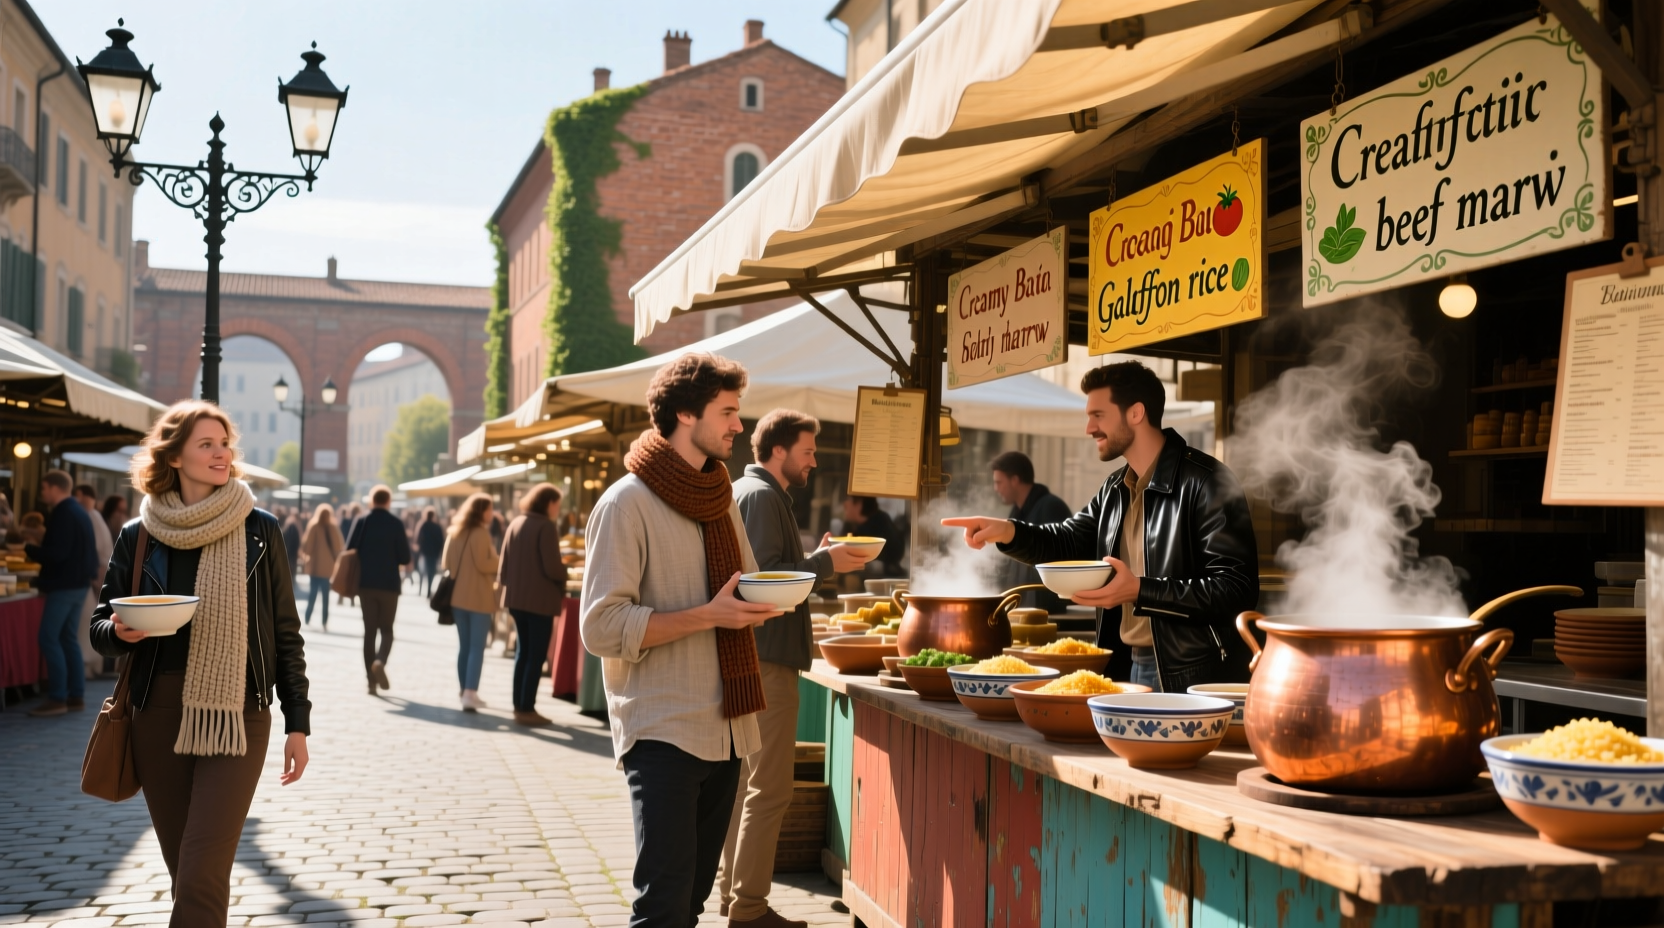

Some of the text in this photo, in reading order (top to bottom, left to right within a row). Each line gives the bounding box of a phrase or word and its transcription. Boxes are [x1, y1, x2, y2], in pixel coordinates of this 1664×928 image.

[1375, 177, 1451, 251] beef
[1188, 258, 1229, 300] rice
[959, 284, 1009, 320] Creamy
